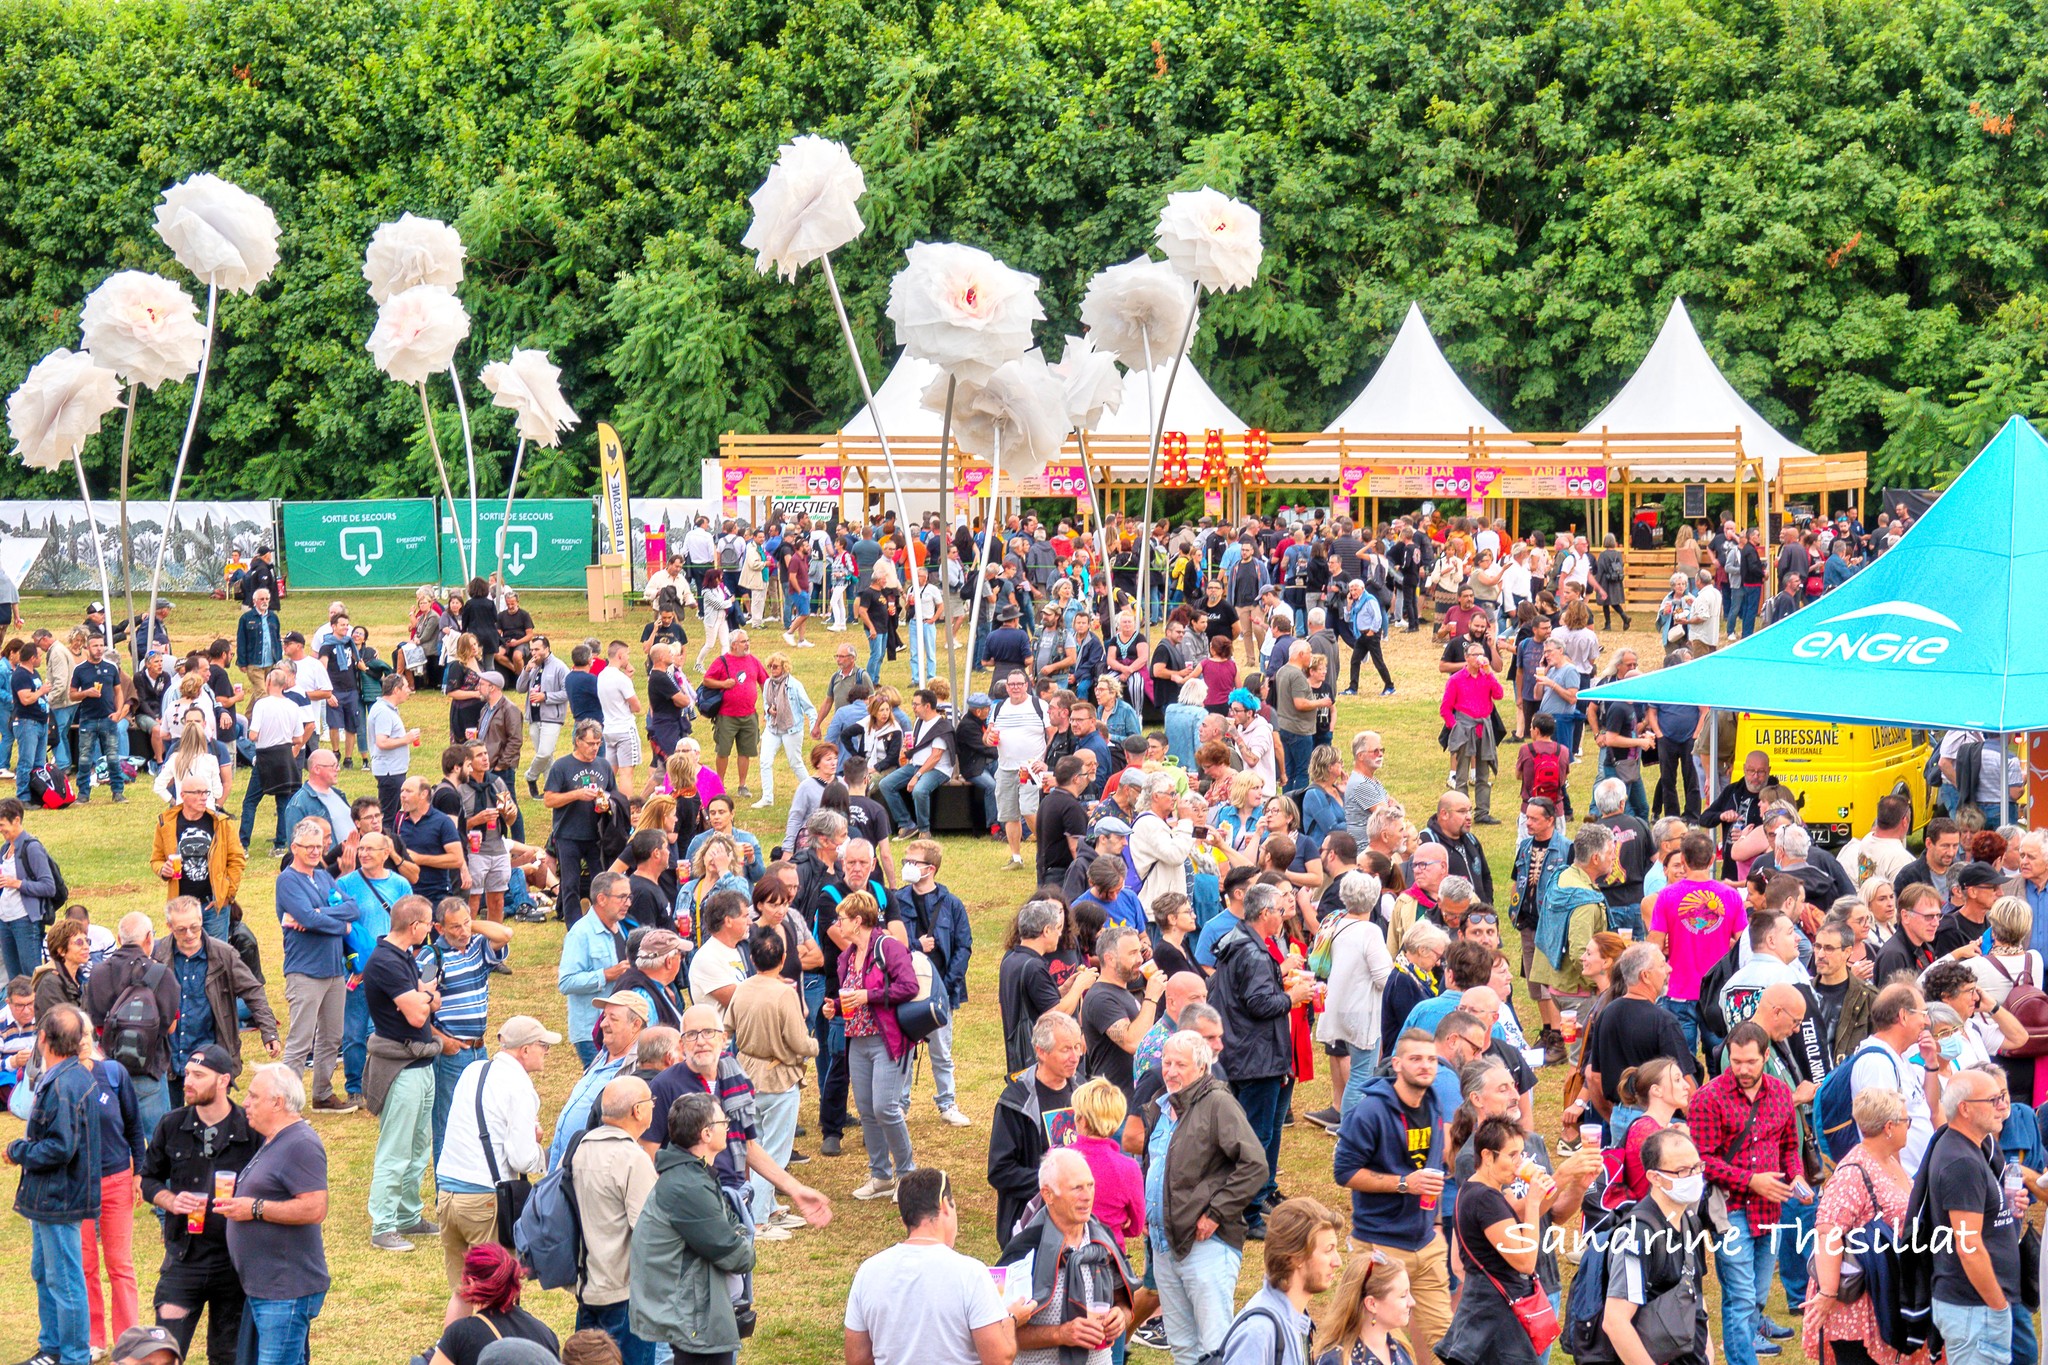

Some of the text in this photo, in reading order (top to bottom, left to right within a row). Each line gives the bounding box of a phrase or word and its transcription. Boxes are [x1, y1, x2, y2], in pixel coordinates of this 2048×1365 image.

[1163, 428, 1269, 487] BAR
[774, 467, 826, 477] TARIF BAR
[1049, 466, 1070, 477] BAR
[1397, 466, 1454, 477] TARIF BAR
[1530, 467, 1589, 477] TARIF BAR
[322, 512, 397, 523] SORTIE DE SECOURS
[479, 512, 506, 521] SORTIE
[518, 512, 554, 521] SECOURS
[396, 536, 426, 544] EMERGENCY
[1756, 729, 1839, 746] LA BRESSANE
[1790, 747, 1822, 755] ARTISANALE
[1790, 774, 1798, 783] ÇA
[1801, 774, 1818, 782] VOUS
[1820, 774, 1841, 782] TENTE
[1805, 1044, 1820, 1060] TO
